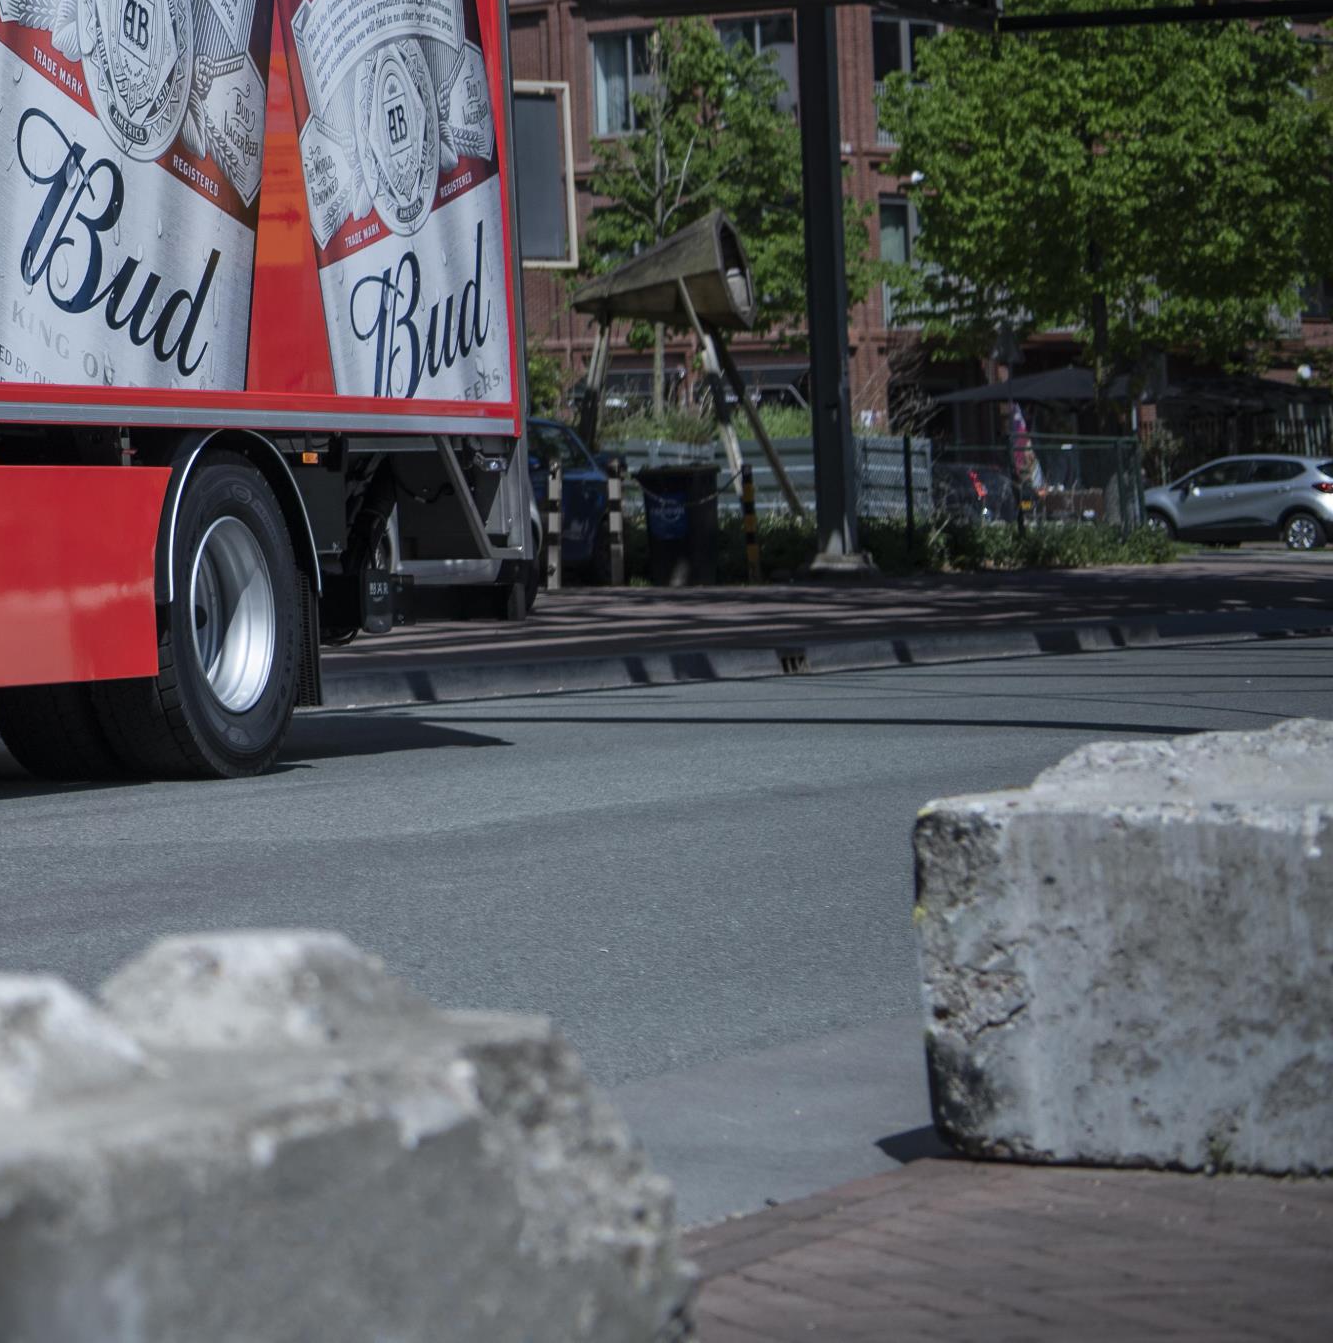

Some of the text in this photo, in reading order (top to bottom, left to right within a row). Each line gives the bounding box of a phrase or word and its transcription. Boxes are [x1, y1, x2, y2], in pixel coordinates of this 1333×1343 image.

[96, 24, 110, 73] AFRICA
[33, 45, 83, 97] TRADE MARK
[155, 82, 171, 110] ASIA
[112, 110, 145, 141] AMERICA
[387, 104, 408, 146] AB
[173, 154, 219, 198] REGISTERED
[440, 170, 473, 198] REGISTERED
[16, 107, 221, 377] Bud
[345, 222, 381, 248] TRADE MARK
[13, 300, 71, 359] KING
[350, 220, 491, 399] Bud
[15, 357, 31, 378] BY
